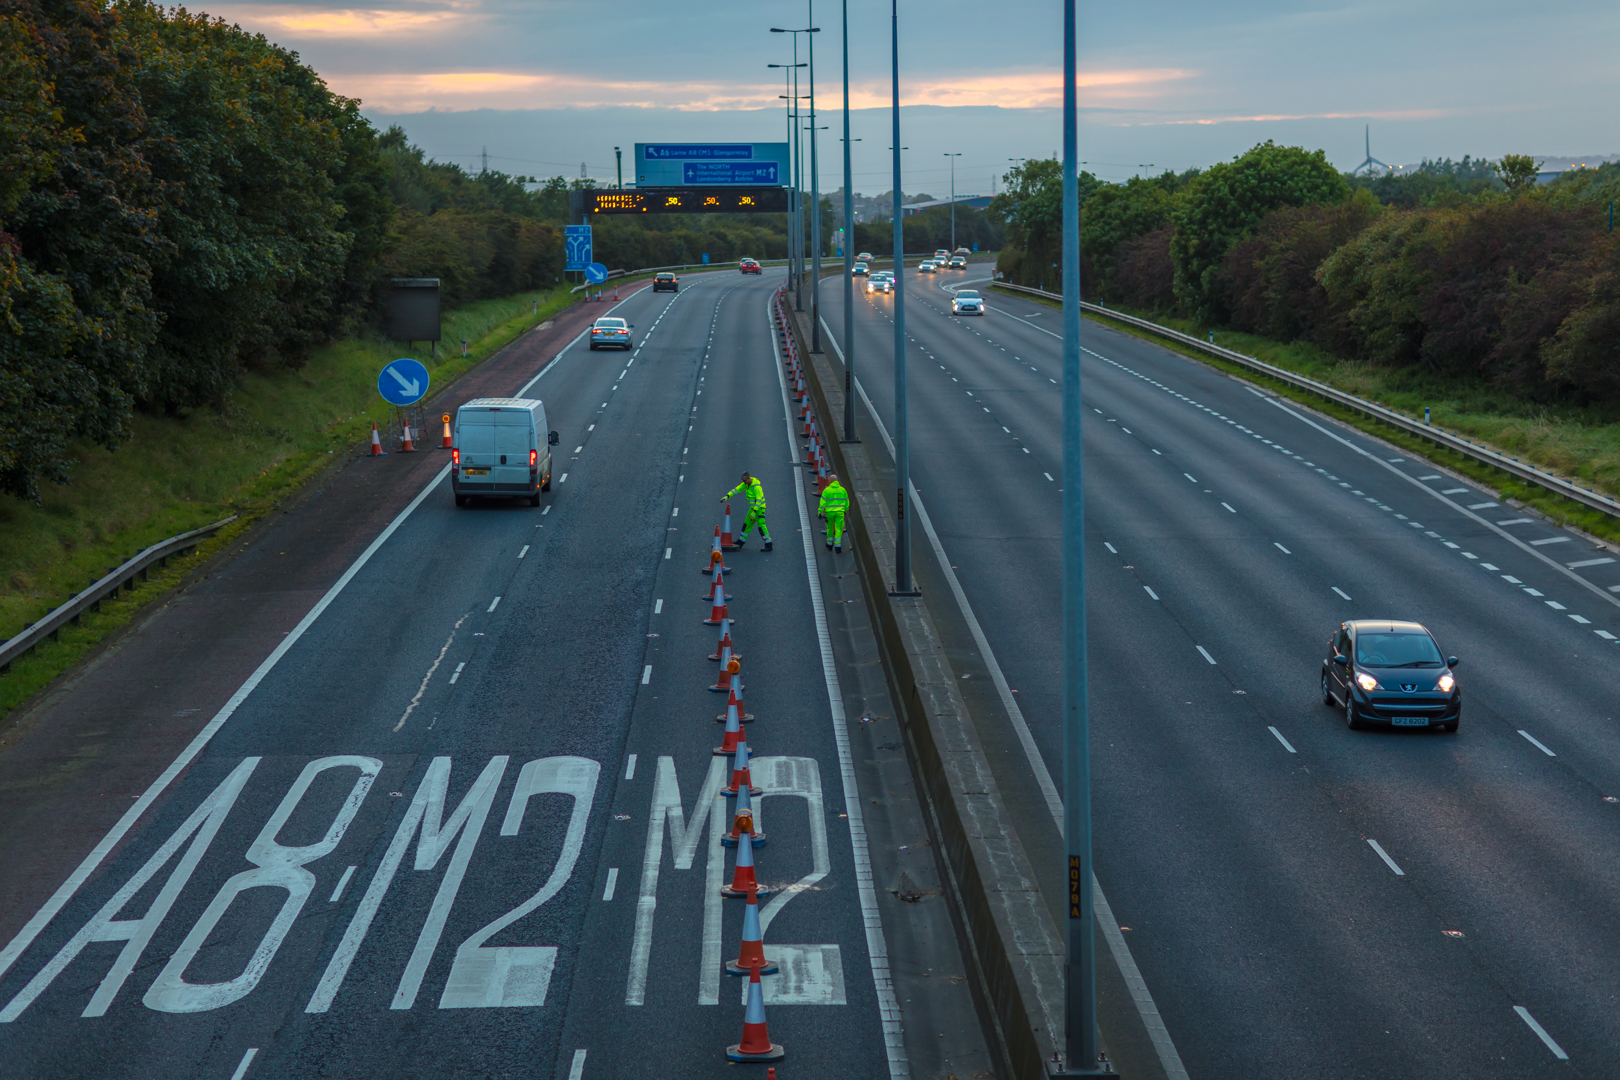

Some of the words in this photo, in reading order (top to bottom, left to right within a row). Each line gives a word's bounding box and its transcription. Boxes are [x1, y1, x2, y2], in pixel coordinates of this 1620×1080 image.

[0, 755, 384, 1023] A8
[304, 755, 600, 1012] M2
[625, 755, 848, 1006] M2
[1070, 857, 1079, 916] M079A
